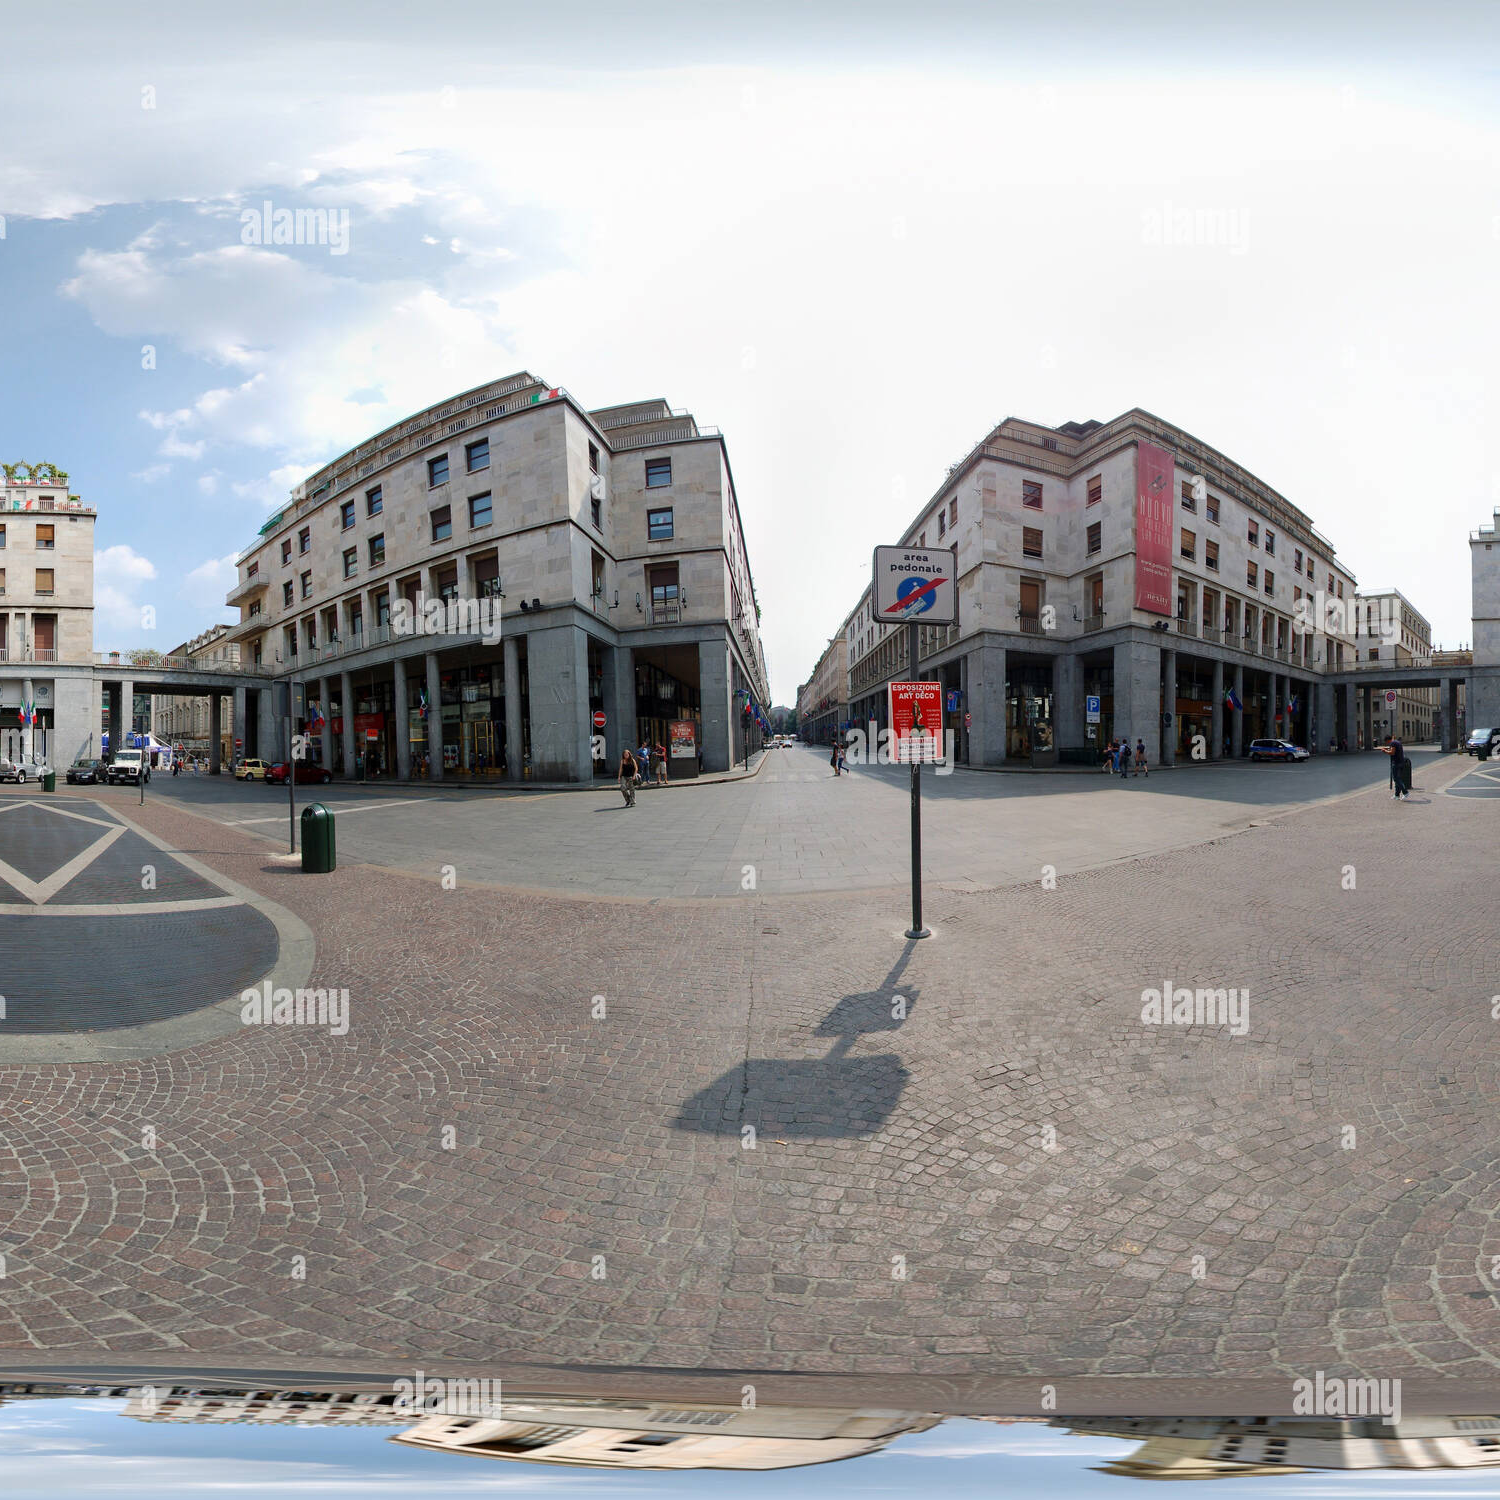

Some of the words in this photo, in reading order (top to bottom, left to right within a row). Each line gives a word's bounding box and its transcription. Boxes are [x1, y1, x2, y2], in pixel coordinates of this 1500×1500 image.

[890, 563, 942, 573] pedonale
[899, 691, 913, 699] ART
[1090, 699, 1098, 711] P
